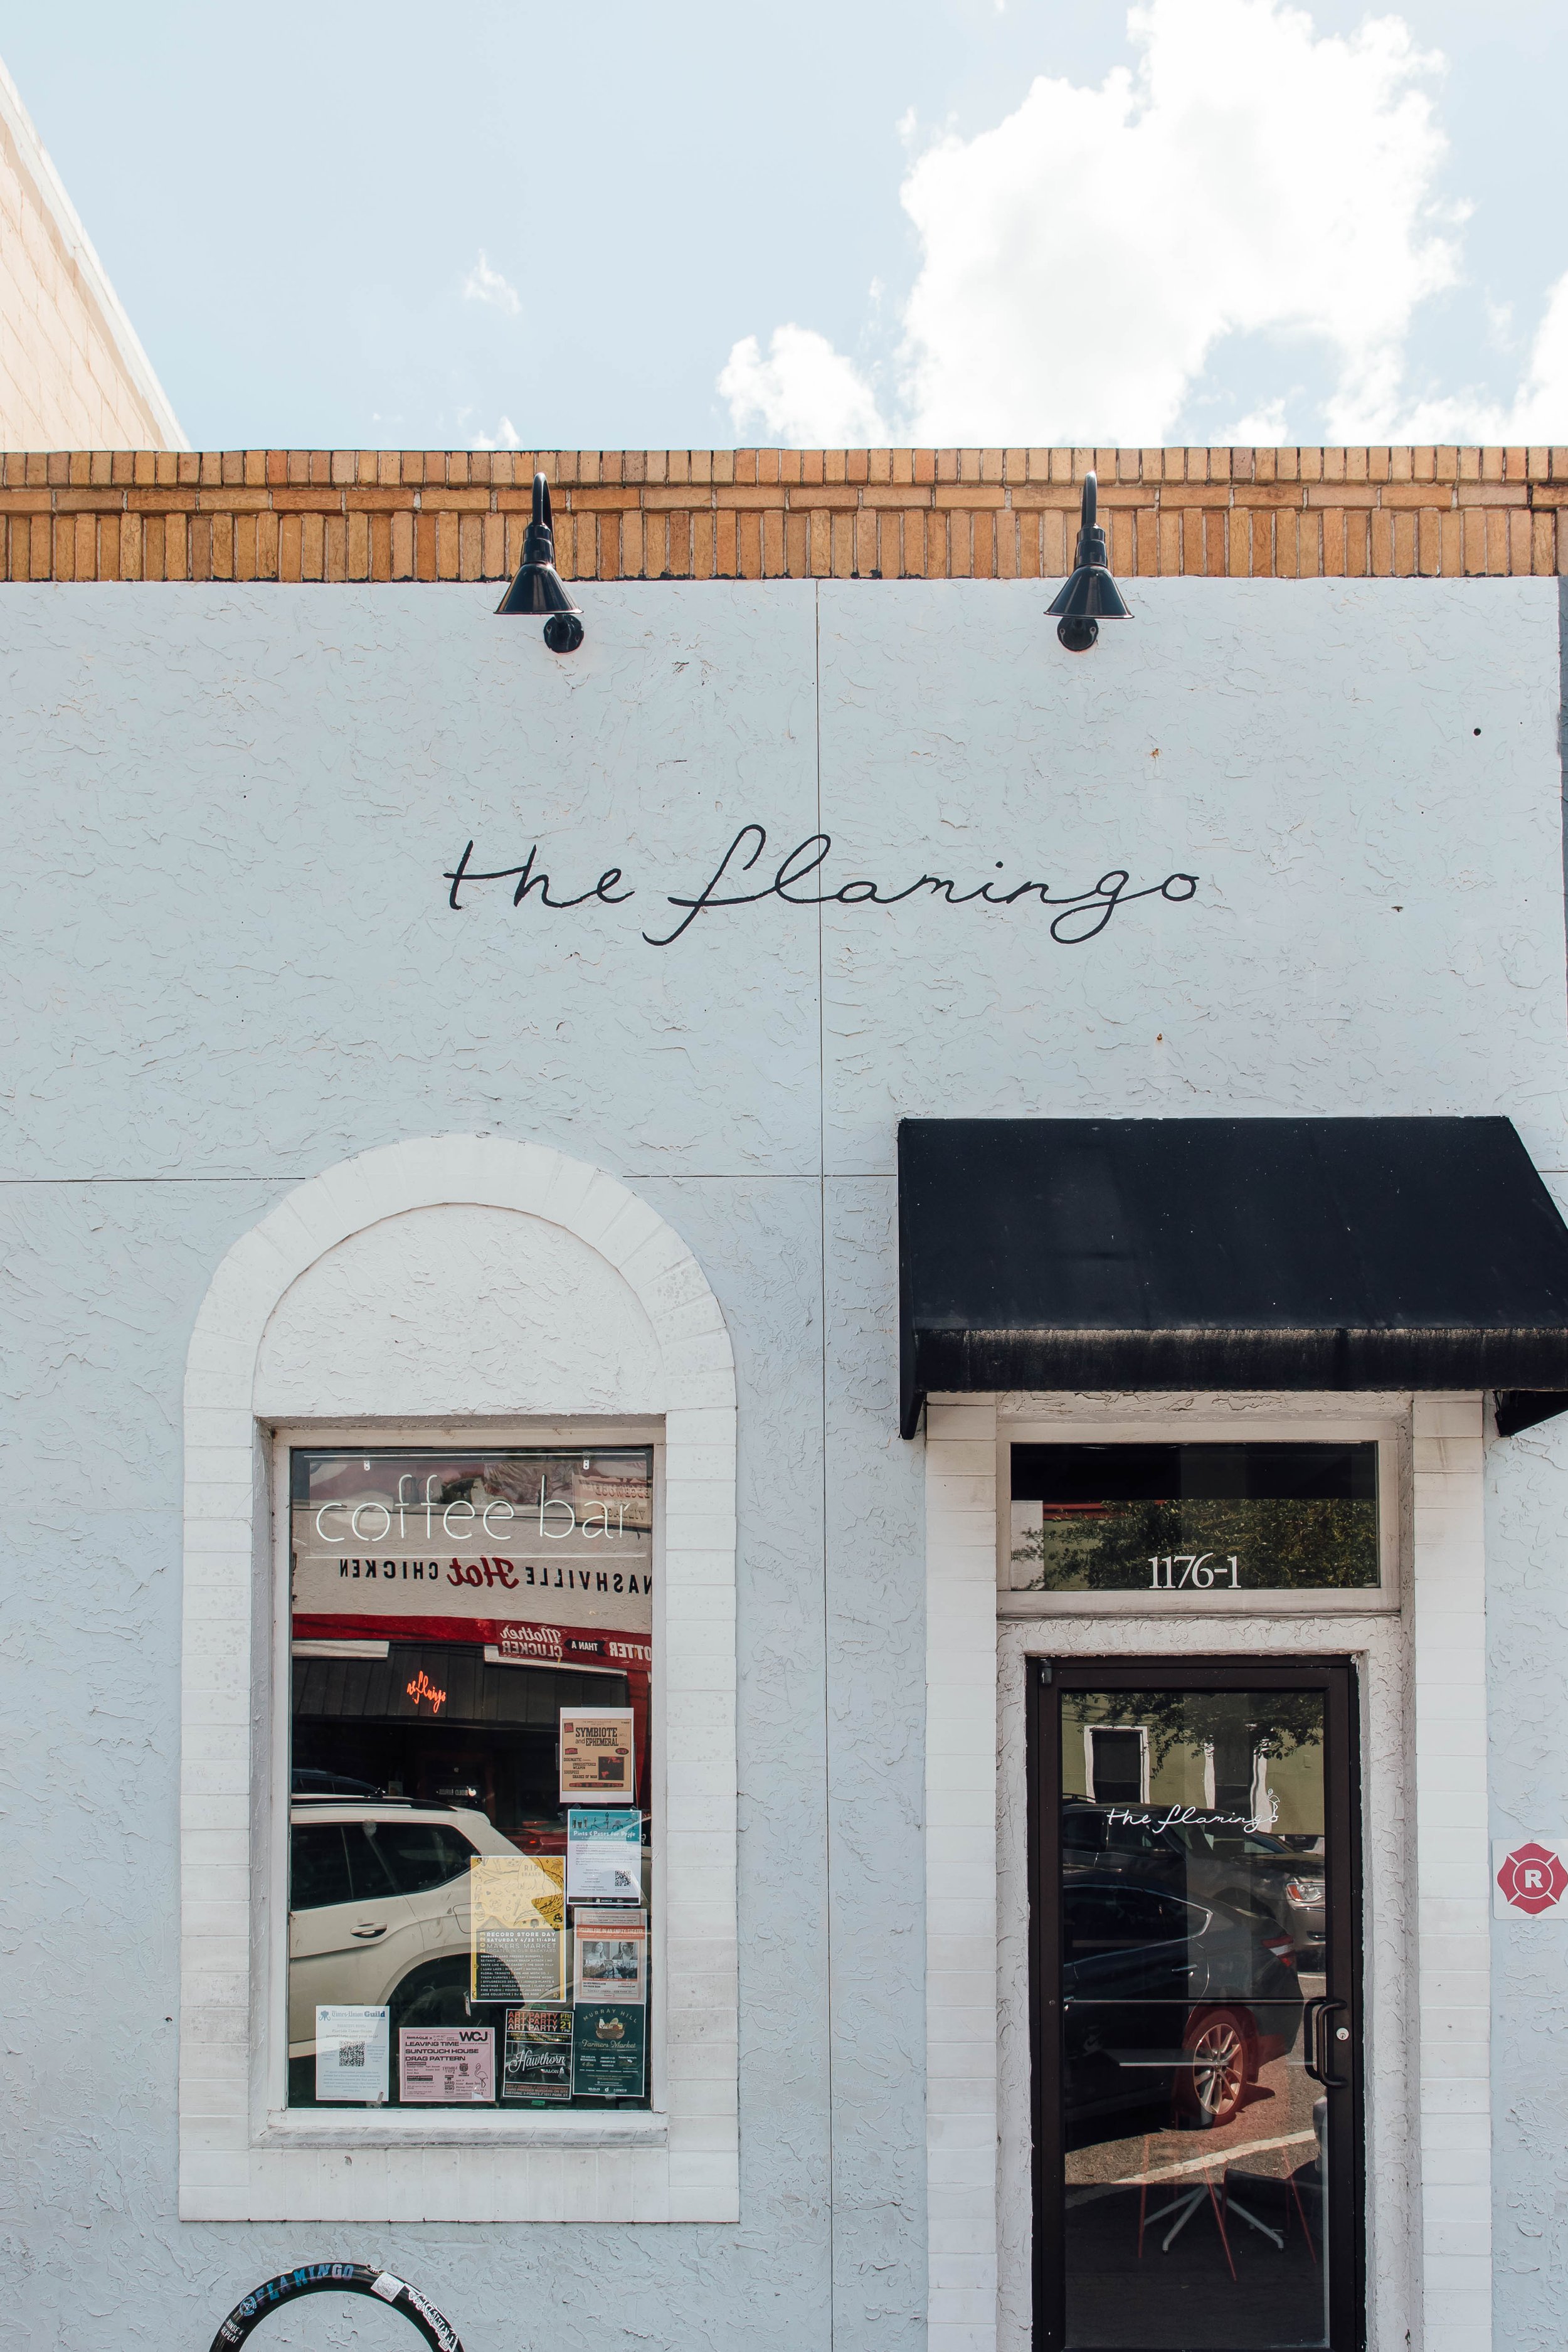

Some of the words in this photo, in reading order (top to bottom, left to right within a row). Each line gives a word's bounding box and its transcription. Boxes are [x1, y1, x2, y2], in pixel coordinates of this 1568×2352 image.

[443, 840, 634, 909] the
[642, 824, 1199, 946] flamingo
[316, 1474, 515, 1542] coffee
[539, 1474, 632, 1539] bar
[1148, 1552, 1241, 1589] 1176-1
[575, 1727, 617, 1737] SYMBIOTE
[586, 1738, 618, 1746] EPHEMERAL
[1107, 1808, 1152, 1825] the
[1152, 1804, 1279, 1833] flamingo
[1525, 1870, 1544, 1888] R
[583, 2008, 616, 2021] MURRAY
[620, 2011, 637, 2023] HILL
[528, 2024, 558, 2032] PARTY
[560, 2021, 571, 2030] 21
[459, 2032, 488, 2042] WCJ
[581, 2039, 609, 2047] Farmers
[610, 2040, 637, 2048] Market
[509, 2050, 566, 2073] Hawthorn
[255, 2264, 354, 2306] FLAMINGO
[226, 2318, 240, 2334] RINSE
[221, 2326, 239, 2343] REPEAT
